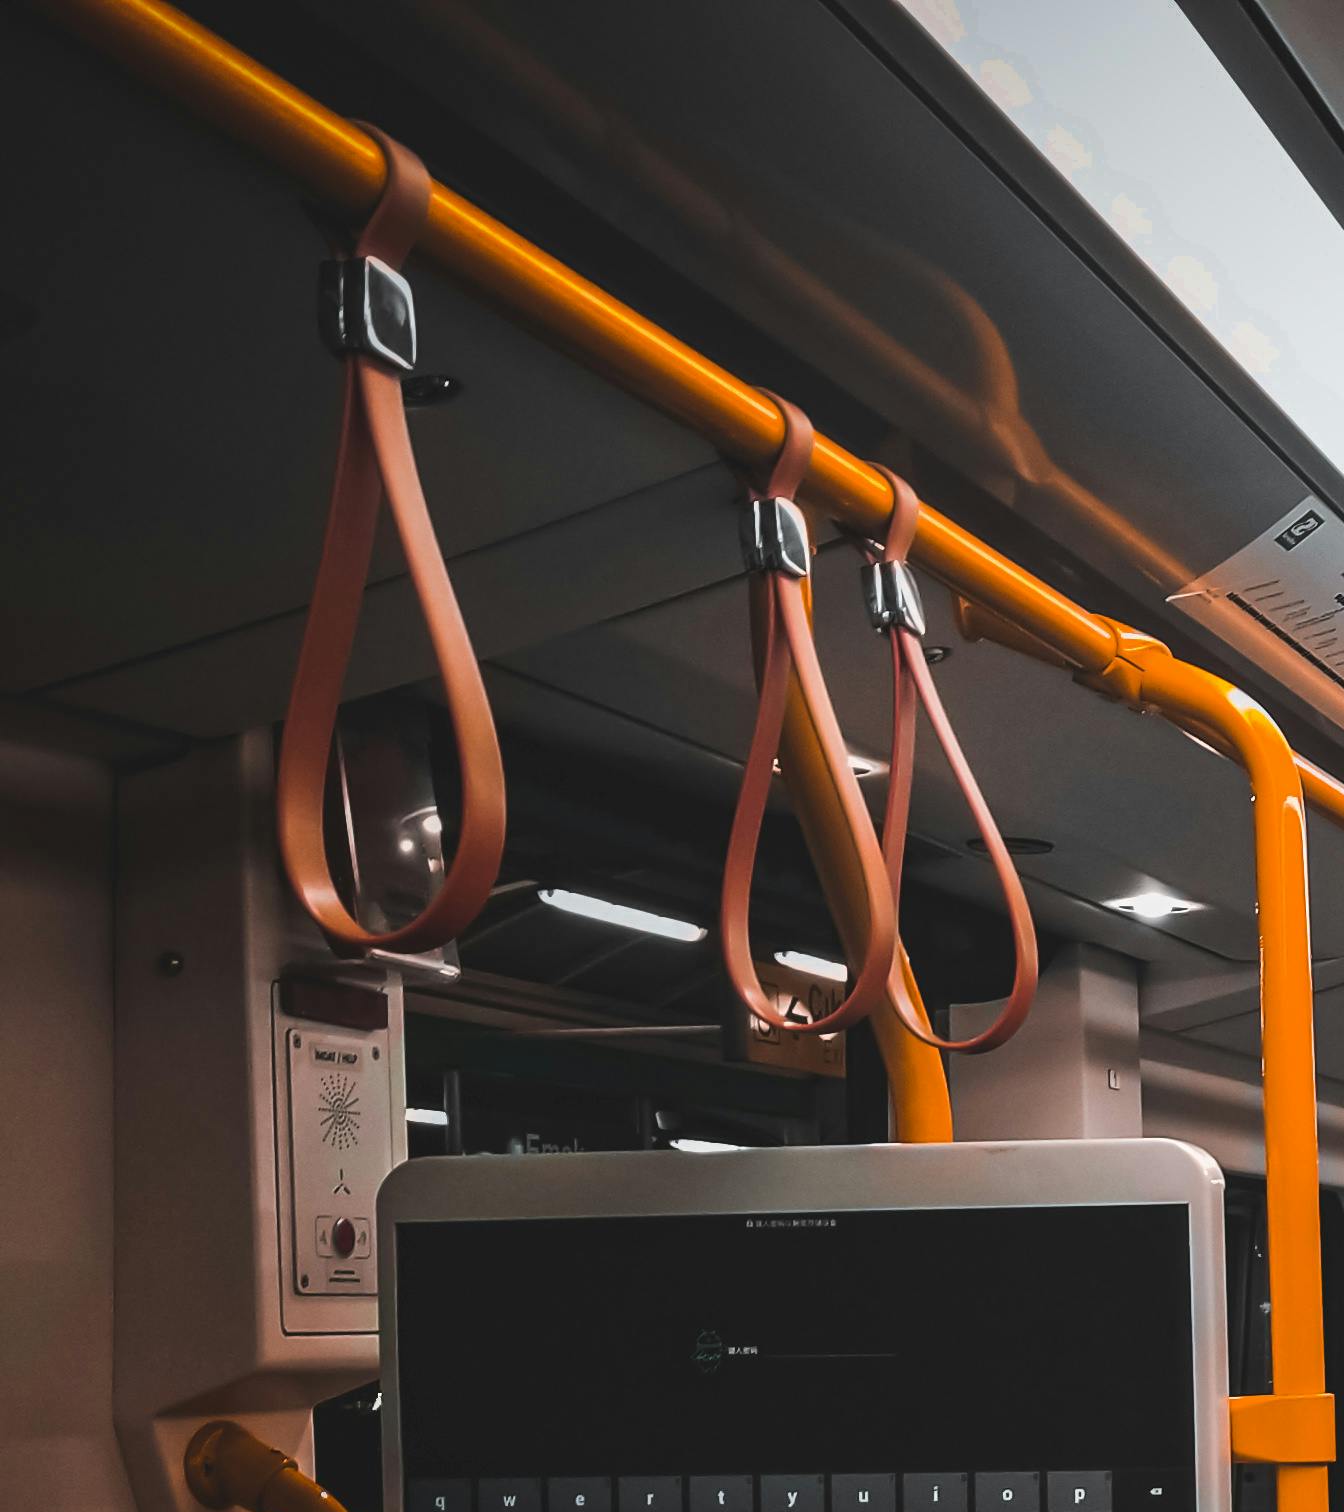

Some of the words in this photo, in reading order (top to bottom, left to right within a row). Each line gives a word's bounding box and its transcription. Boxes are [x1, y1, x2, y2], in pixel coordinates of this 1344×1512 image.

[435, 1495, 447, 1512] q
[503, 1494, 517, 1508] w
[575, 1493, 586, 1507] e
[646, 1492, 655, 1506] r
[717, 1489, 726, 1505] t
[786, 1490, 799, 1508] y
[857, 1489, 870, 1504] u
[932, 1485, 939, 1503] i
[1001, 1488, 1014, 1502] o
[1073, 1487, 1087, 1505] p
